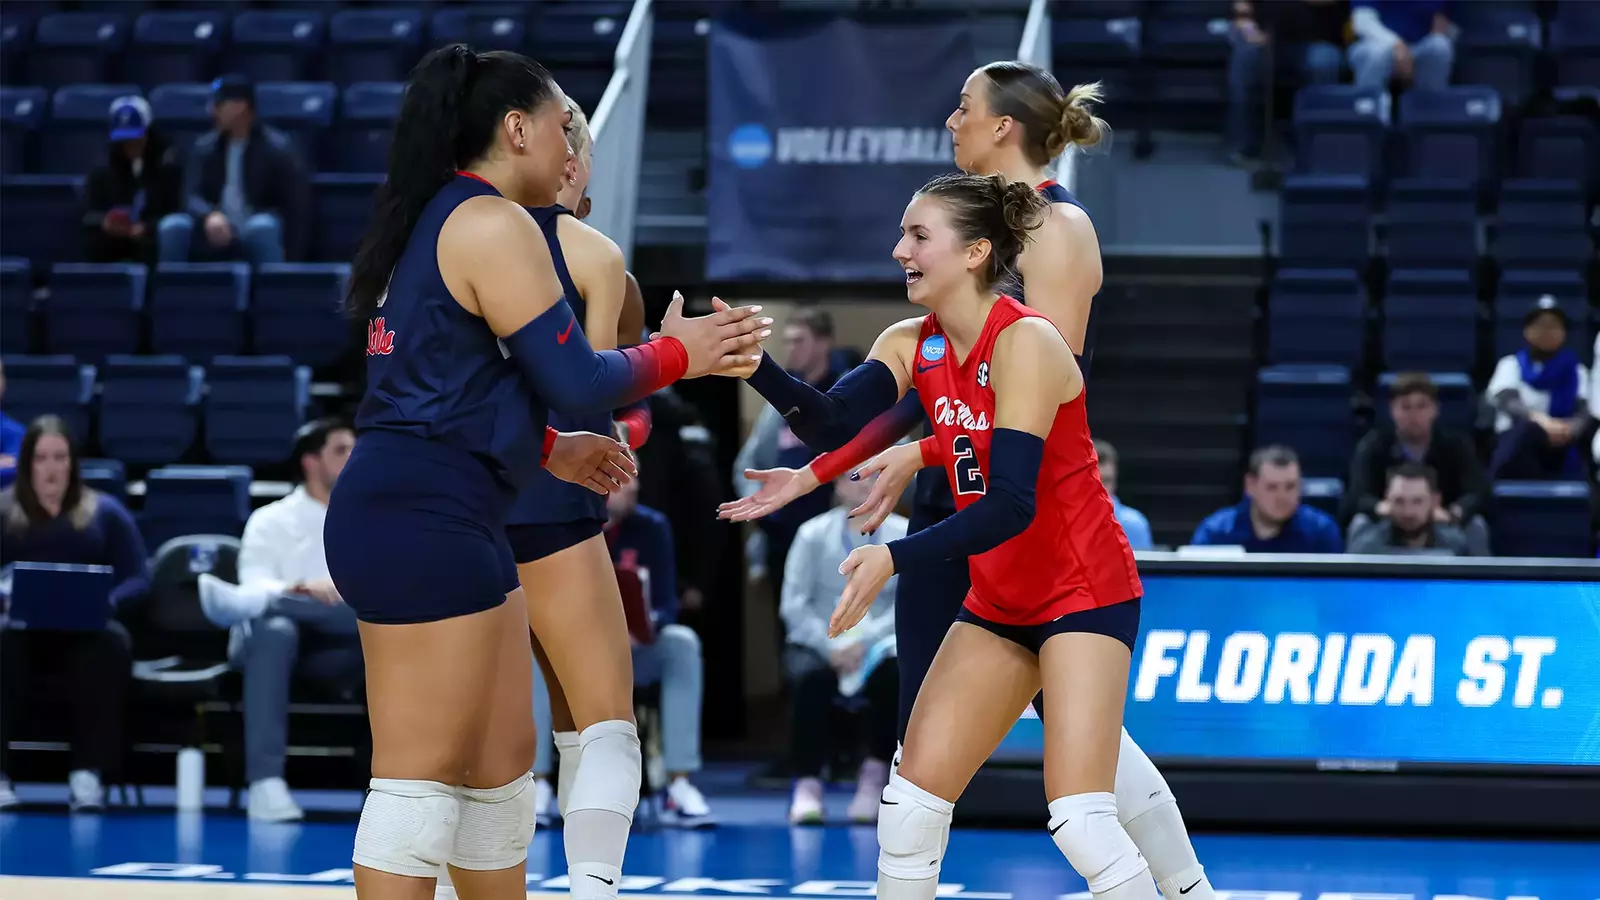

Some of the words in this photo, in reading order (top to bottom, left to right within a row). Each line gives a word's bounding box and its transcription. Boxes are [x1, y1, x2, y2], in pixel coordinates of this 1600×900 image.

[952, 434, 987, 496] 2
[1134, 629, 1436, 706] FLORIDA
[1456, 635, 1564, 708] ST.
